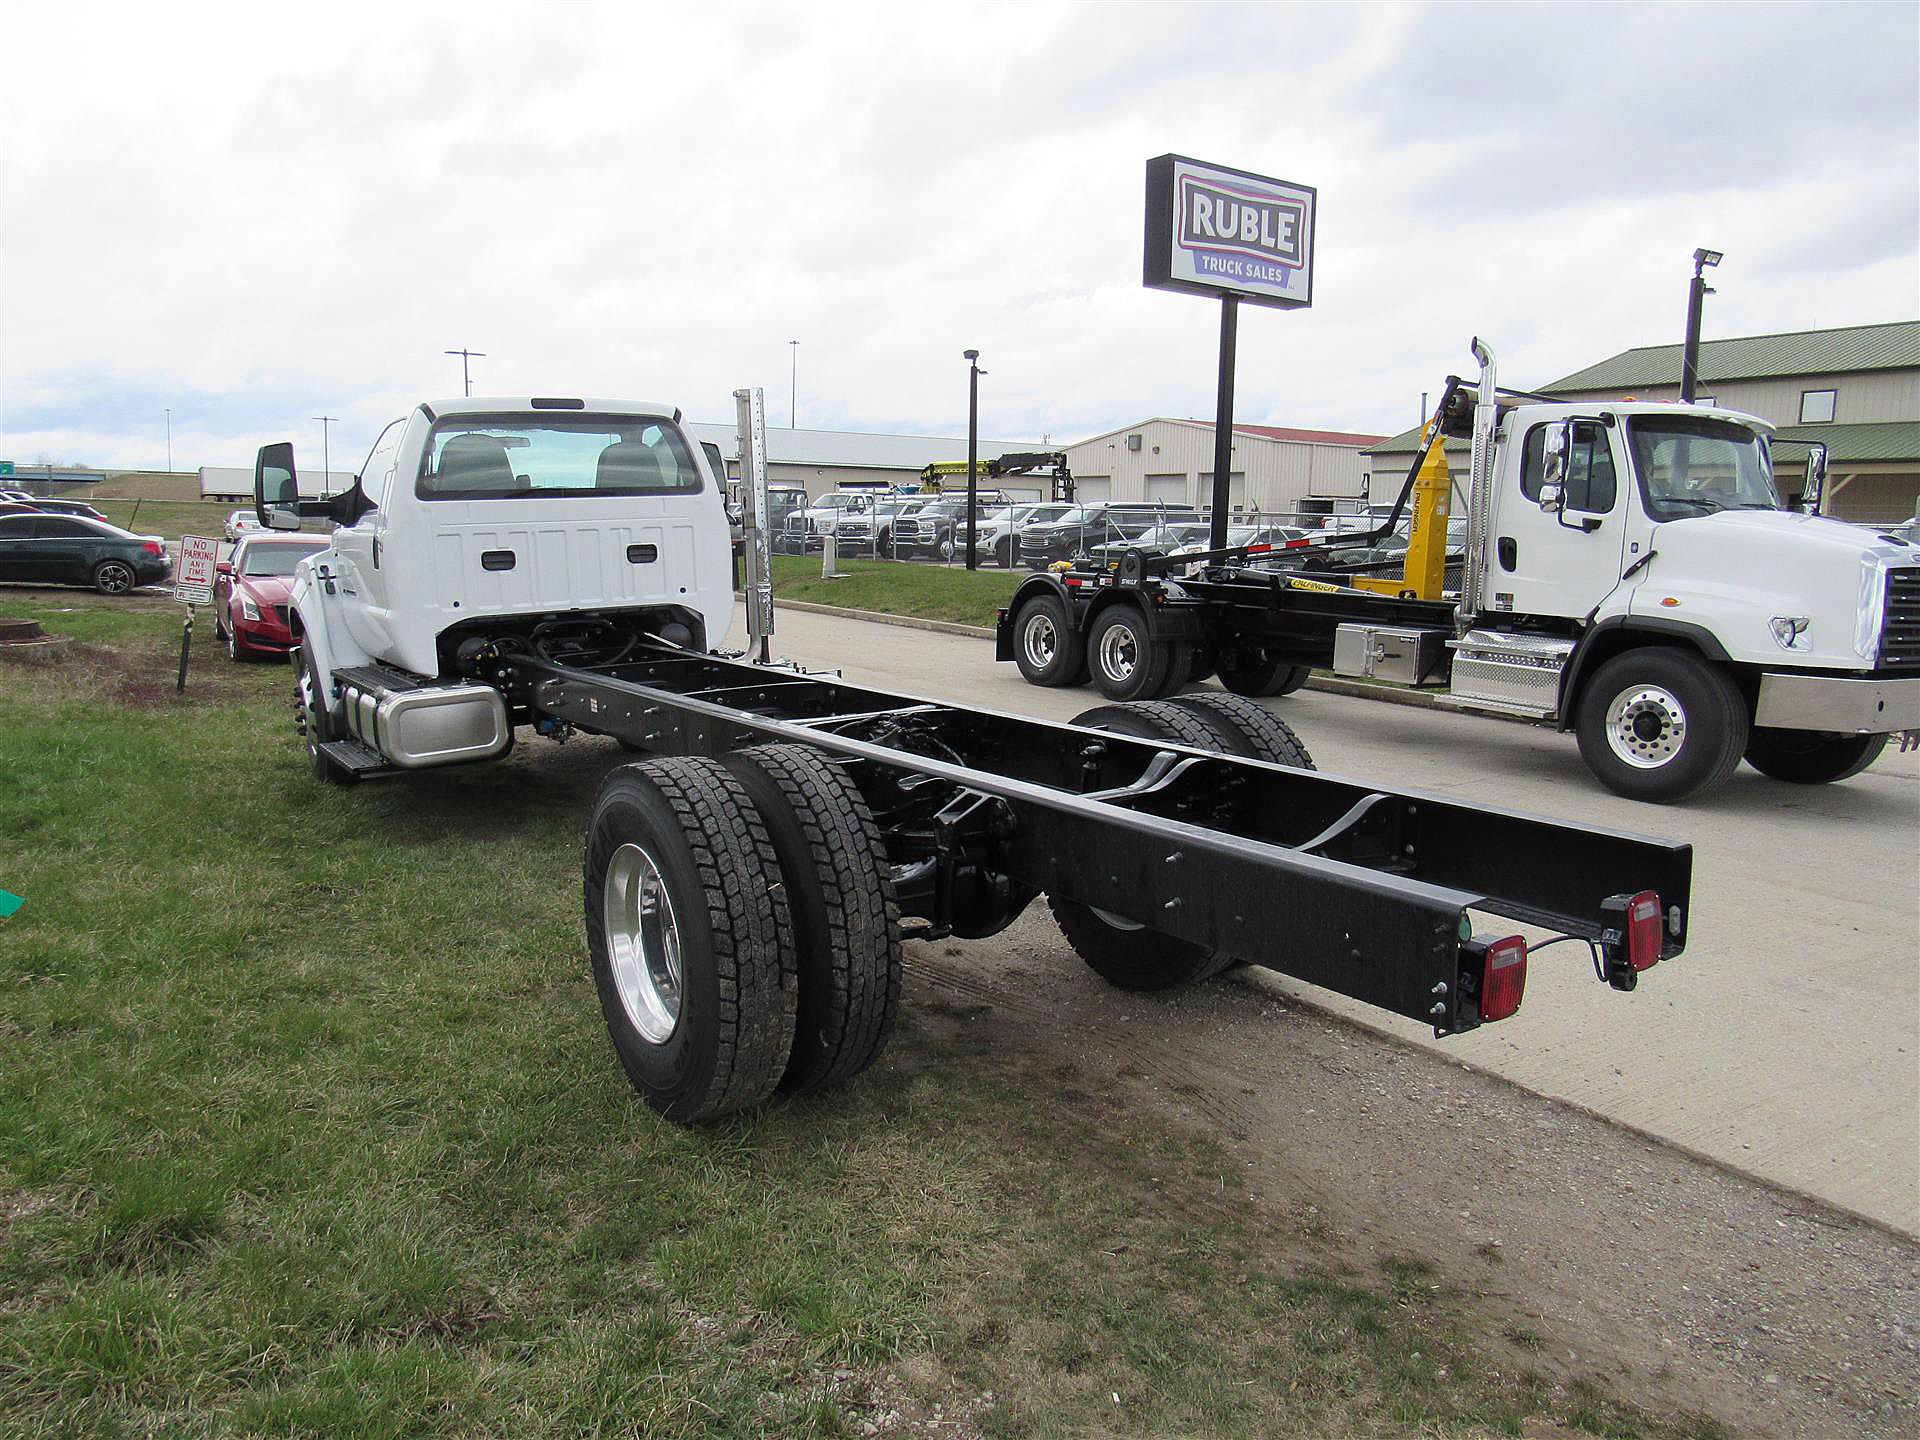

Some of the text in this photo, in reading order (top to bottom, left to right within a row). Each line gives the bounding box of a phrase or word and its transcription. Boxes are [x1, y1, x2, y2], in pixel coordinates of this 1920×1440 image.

[1193, 192, 1295, 253] RUBLE
[1202, 255, 1282, 282] TRUCK SALES
[193, 540, 207, 550] NO
[184, 549, 214, 561] PARKING
[188, 567, 207, 576] TIME
[1292, 579, 1336, 592] PALFINGER
